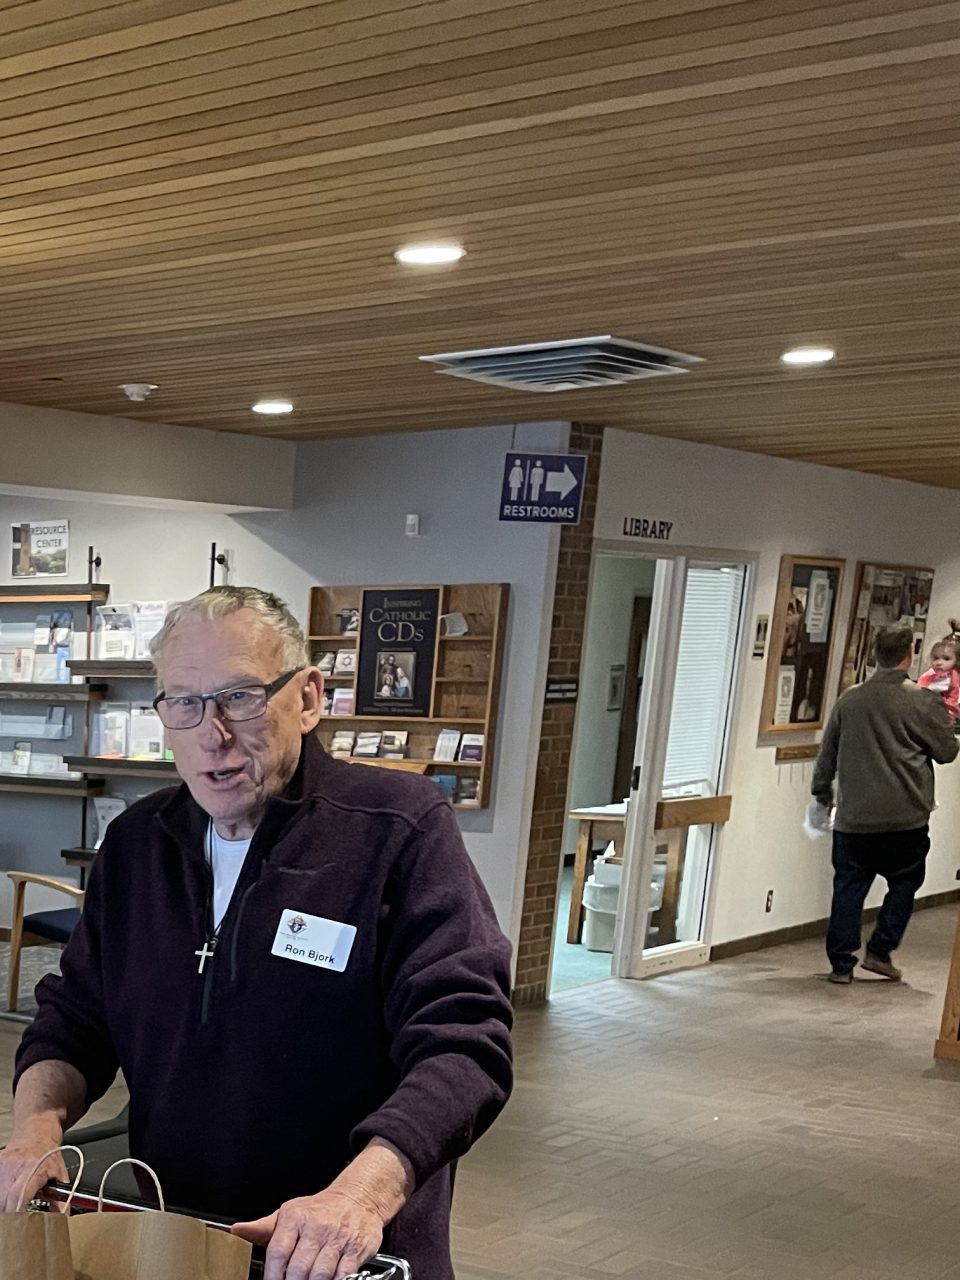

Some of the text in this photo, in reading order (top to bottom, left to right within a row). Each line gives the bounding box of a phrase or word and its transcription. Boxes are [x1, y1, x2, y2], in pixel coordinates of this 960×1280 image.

[503, 504, 575, 519] RESTROOMS
[30, 524, 68, 536] RESOURCE
[622, 517, 673, 540] LIBRARY
[36, 538, 63, 548] CENTER
[369, 607, 431, 623] CATHOLIC
[284, 943, 336, 964] Ron Bjork
